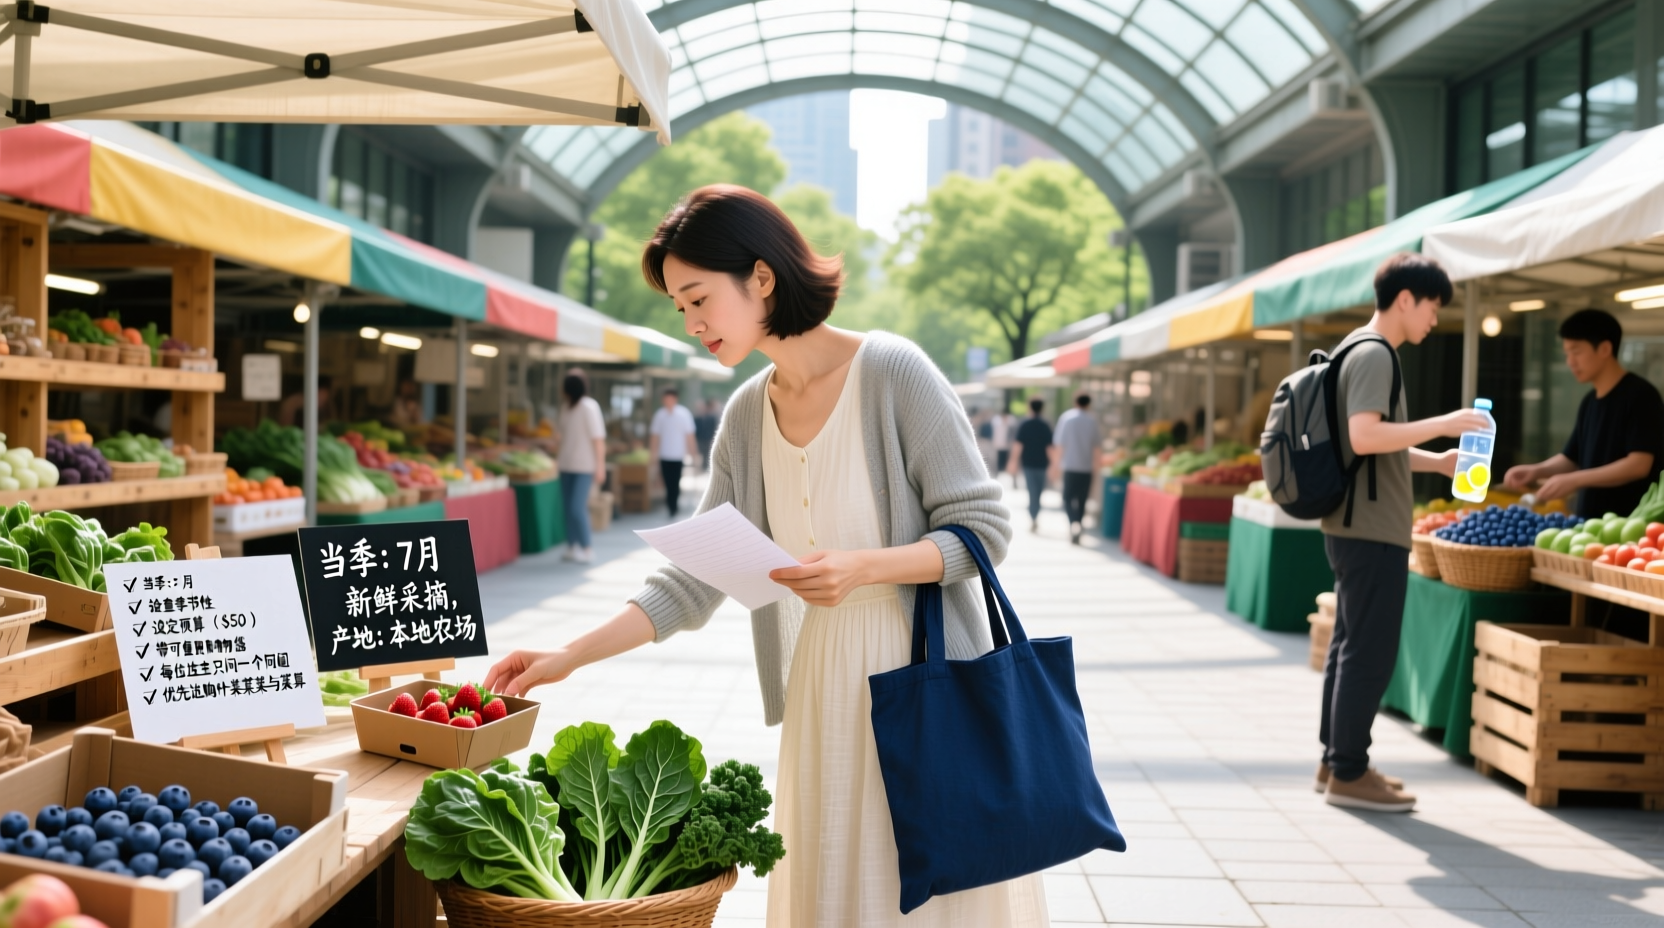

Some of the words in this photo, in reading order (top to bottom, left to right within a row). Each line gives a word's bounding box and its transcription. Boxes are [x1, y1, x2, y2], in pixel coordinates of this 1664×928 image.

[345, 580, 457, 618] 新鲜采摘，
[331, 614, 477, 656] 产地：本地农场
